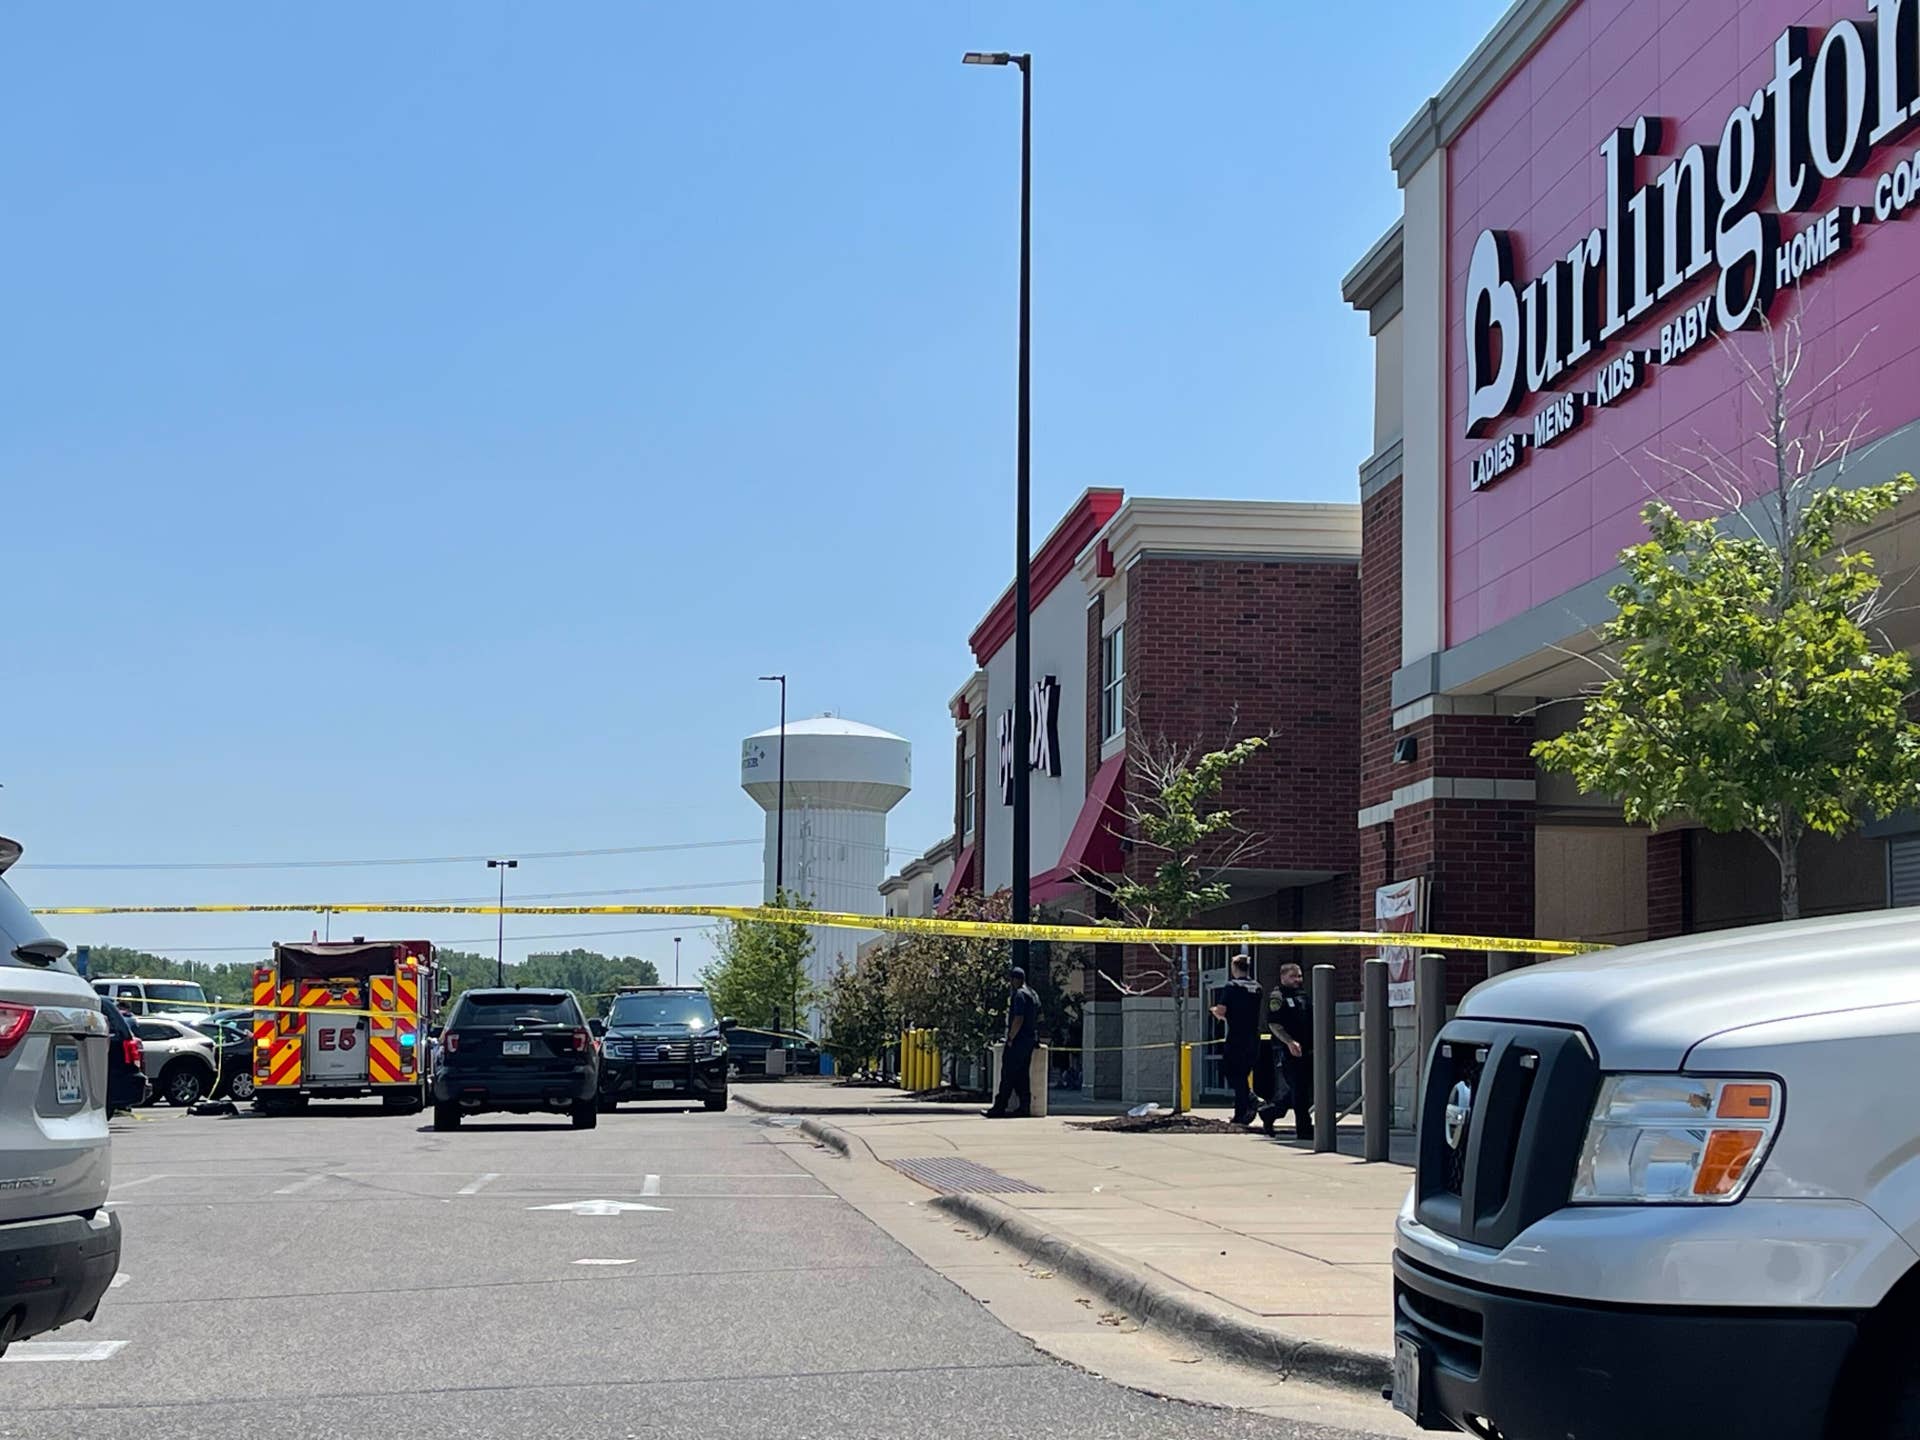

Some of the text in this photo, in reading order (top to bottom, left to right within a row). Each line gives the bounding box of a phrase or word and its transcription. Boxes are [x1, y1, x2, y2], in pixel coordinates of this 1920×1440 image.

[1470, 433, 1515, 491] LADIES
[1534, 392, 1574, 449] MENS
[1597, 350, 1635, 408] KIDS
[1660, 296, 1711, 366] BABY
[1776, 205, 1840, 289] HOME
[318, 1028, 356, 1051] E5
